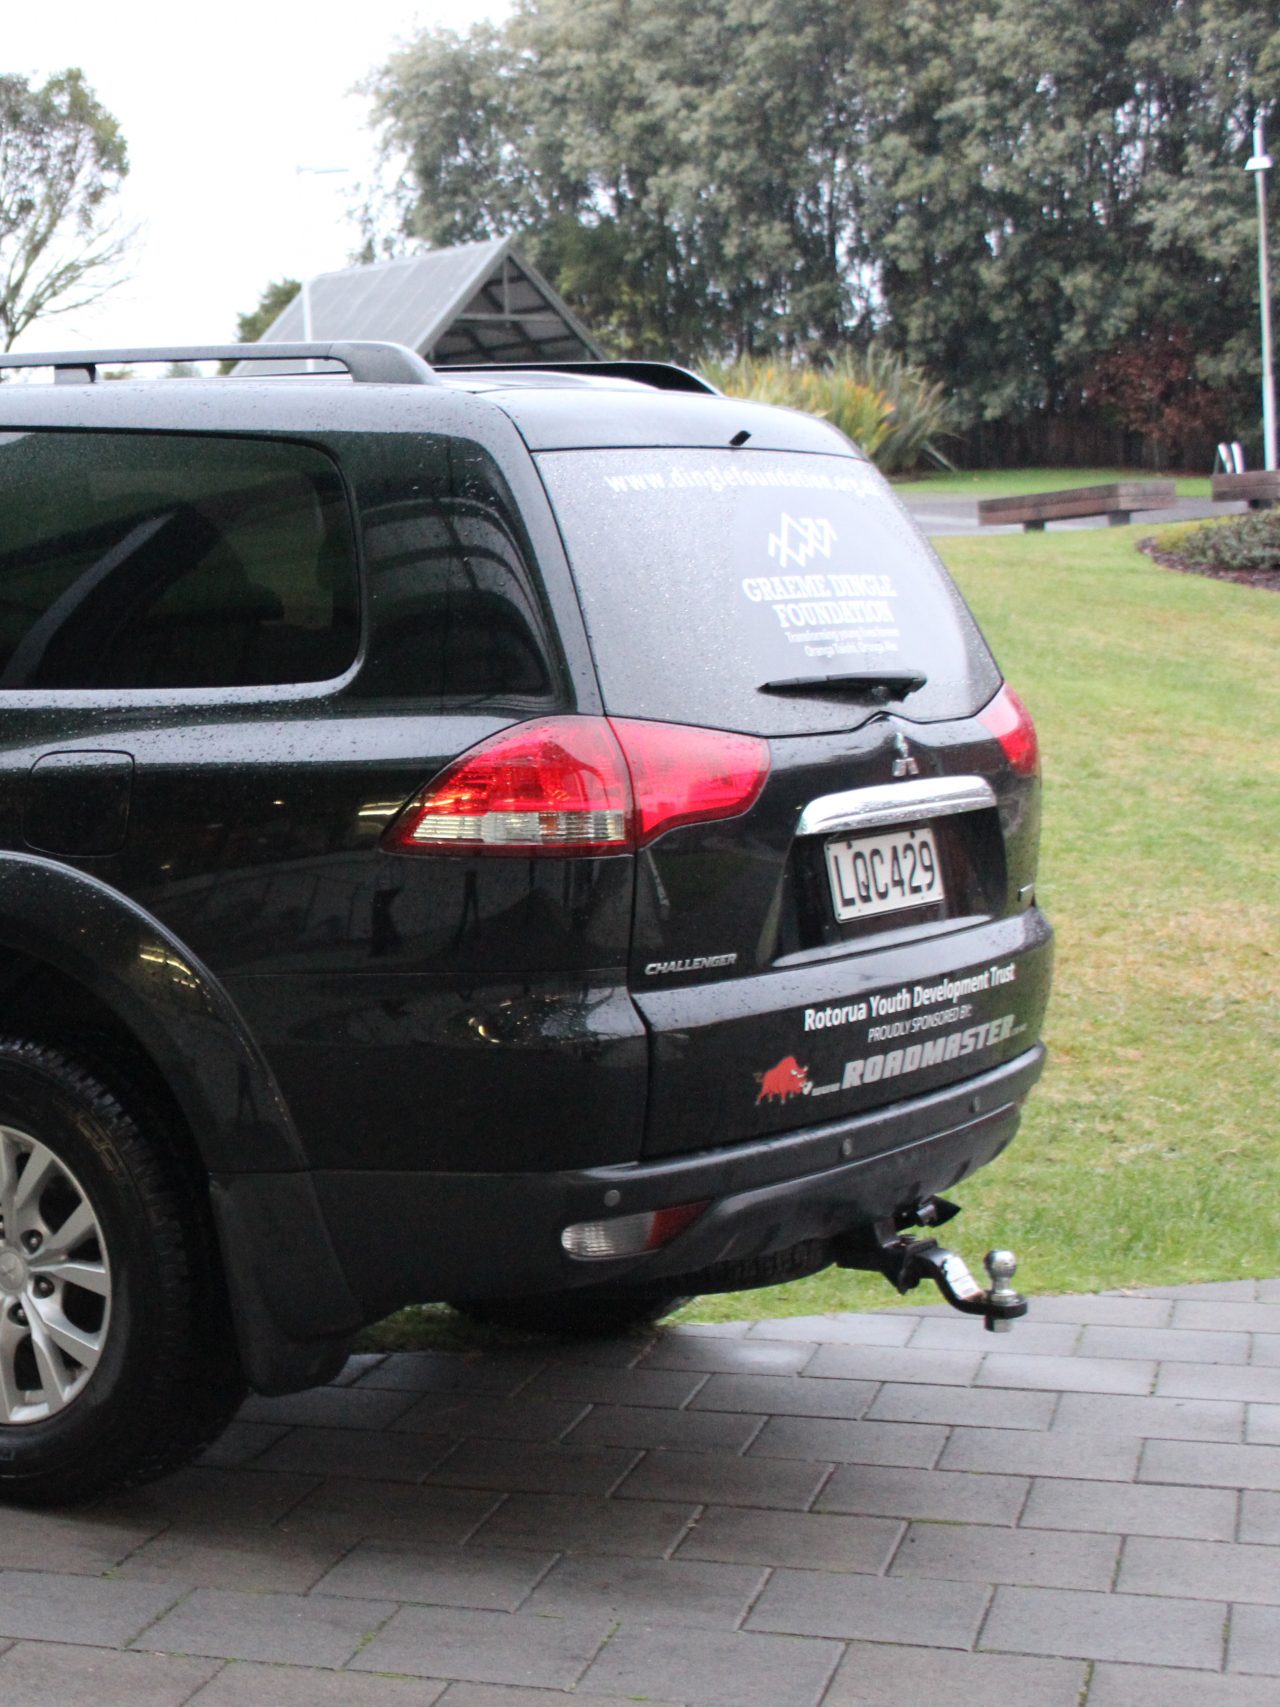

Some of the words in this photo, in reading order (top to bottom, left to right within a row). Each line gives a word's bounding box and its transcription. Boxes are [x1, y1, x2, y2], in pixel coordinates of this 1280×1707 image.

[742, 575, 832, 602] GRAEME
[827, 574, 897, 597] DINGLE
[772, 600, 895, 628] FOUNDATION
[833, 840, 936, 908] LQC429
[644, 953, 738, 975] CHALLENGER
[804, 1001, 867, 1031] Rotorua
[869, 988, 911, 1017] Youth
[913, 969, 989, 1007] Development
[990, 962, 1016, 987] Trust
[867, 1020, 910, 1043] PROUDLY
[911, 1006, 959, 1034] SPONSORED
[841, 1014, 1016, 1090] ROADMASTER
